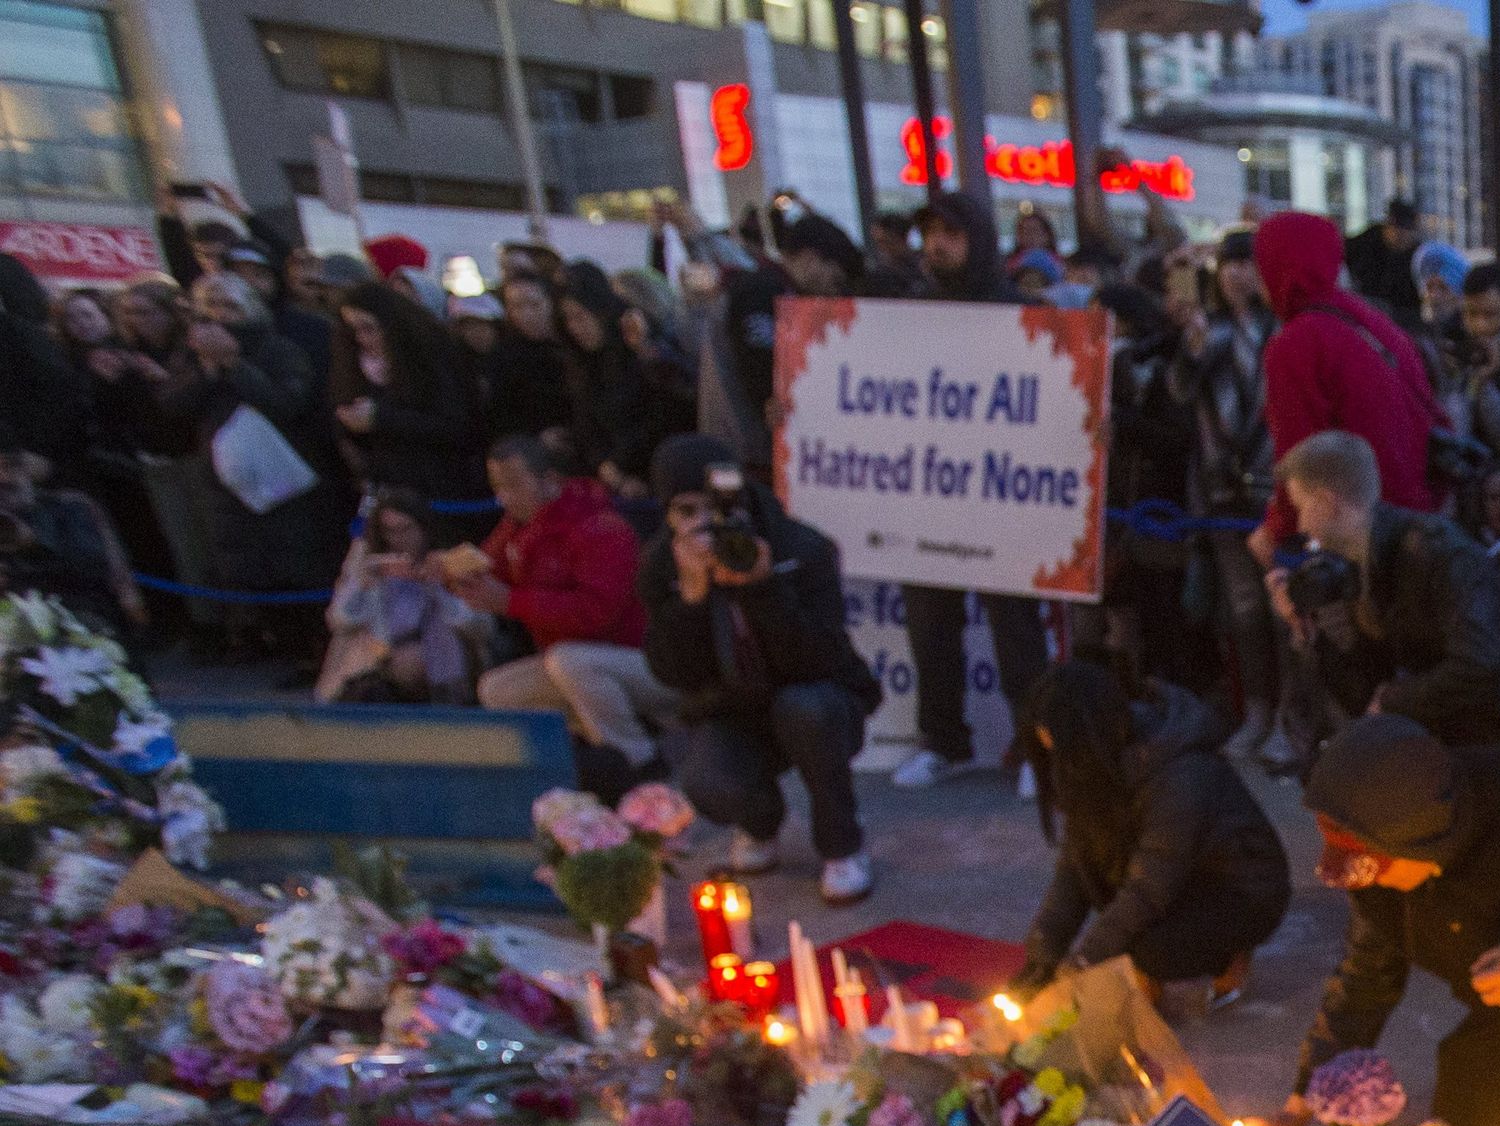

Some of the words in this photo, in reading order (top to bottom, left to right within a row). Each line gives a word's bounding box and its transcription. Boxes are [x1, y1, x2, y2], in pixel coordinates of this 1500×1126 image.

[838, 364, 919, 418] Love
[928, 366, 978, 421] for
[985, 371, 1039, 425] All
[799, 438, 912, 494] Hatred
[923, 445, 973, 497] for
[981, 450, 1080, 508] None
